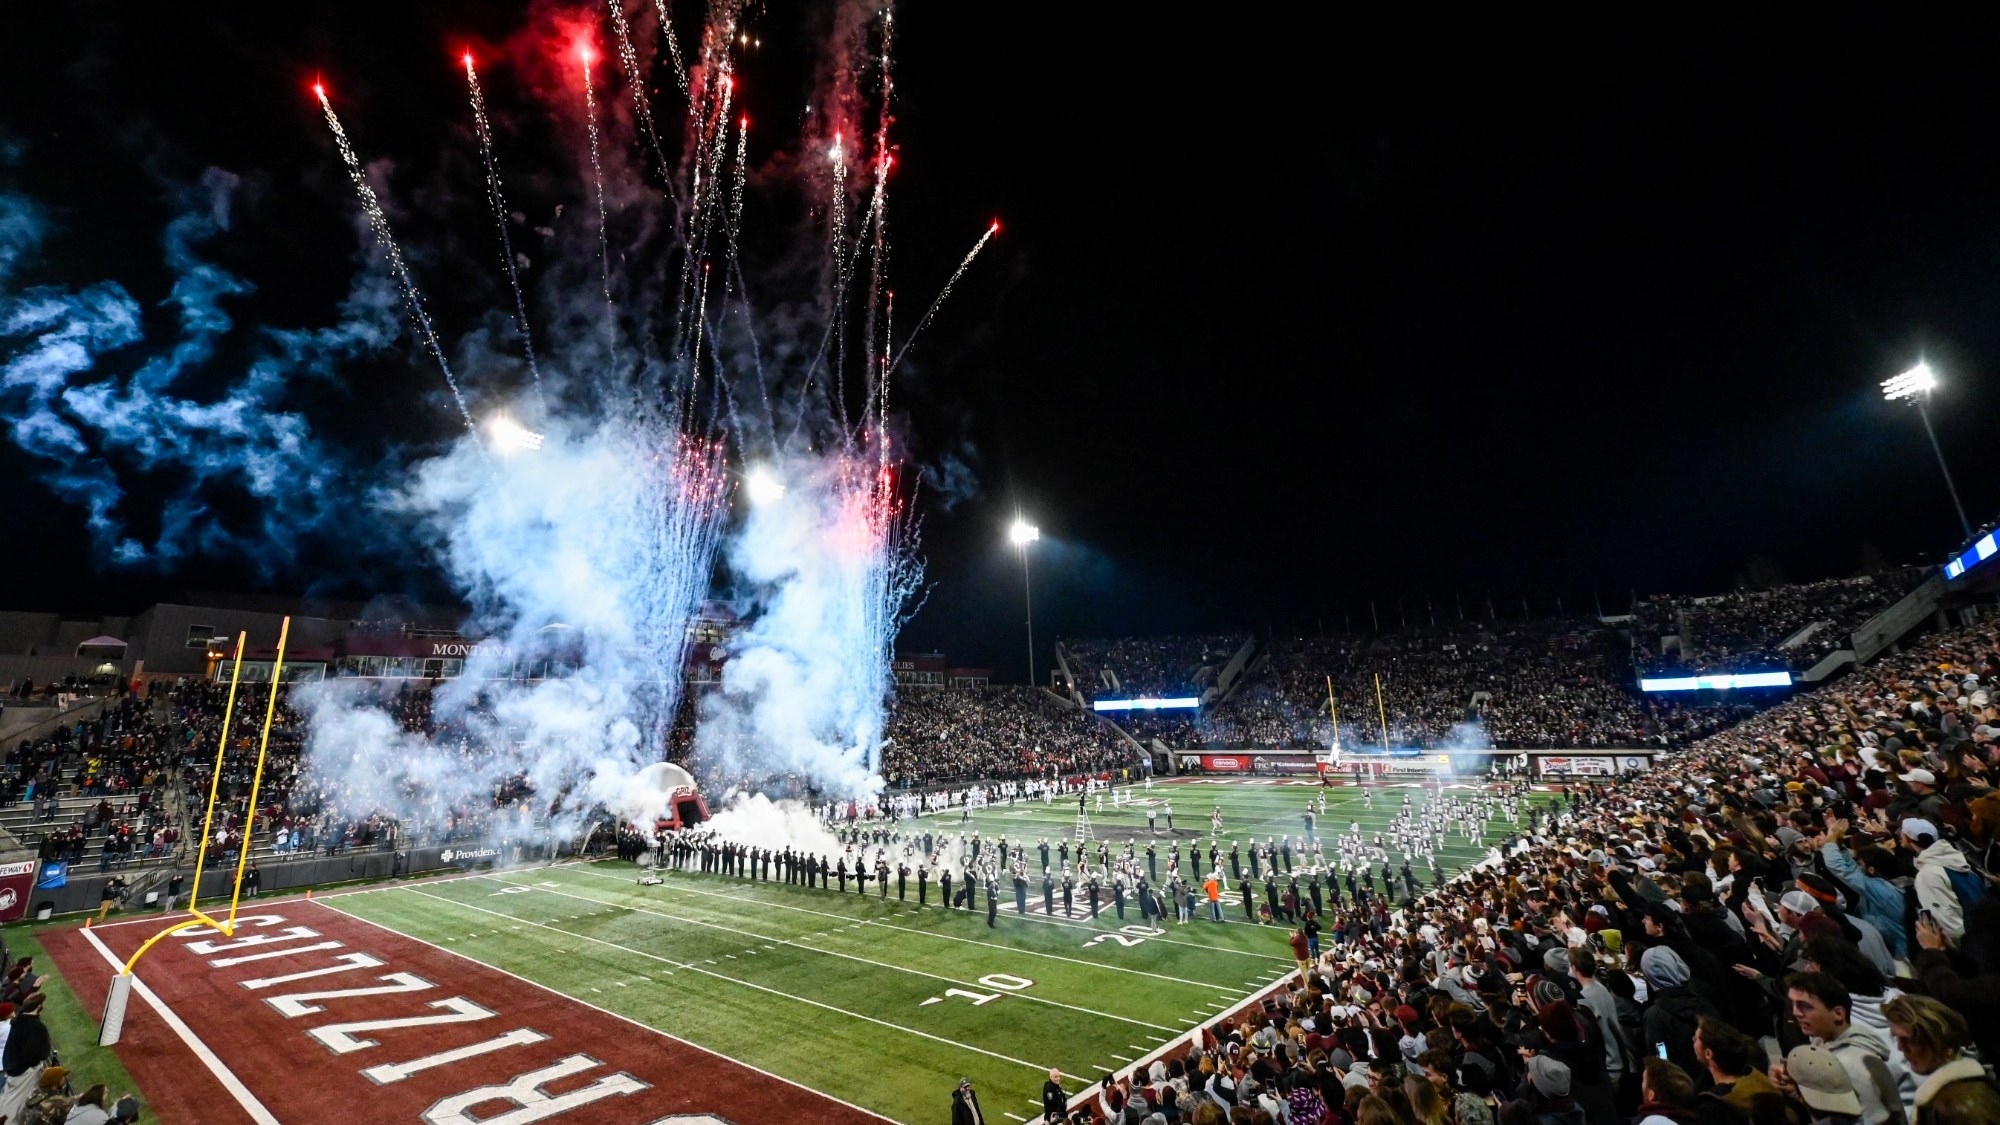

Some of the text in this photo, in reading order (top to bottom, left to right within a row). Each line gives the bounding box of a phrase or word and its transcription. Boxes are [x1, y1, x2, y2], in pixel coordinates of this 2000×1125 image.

[432, 643, 512, 657] MONTANA
[455, 847, 503, 860] Providence
[1093, 924, 1168, 948] 20
[944, 973, 1036, 1006] 10
